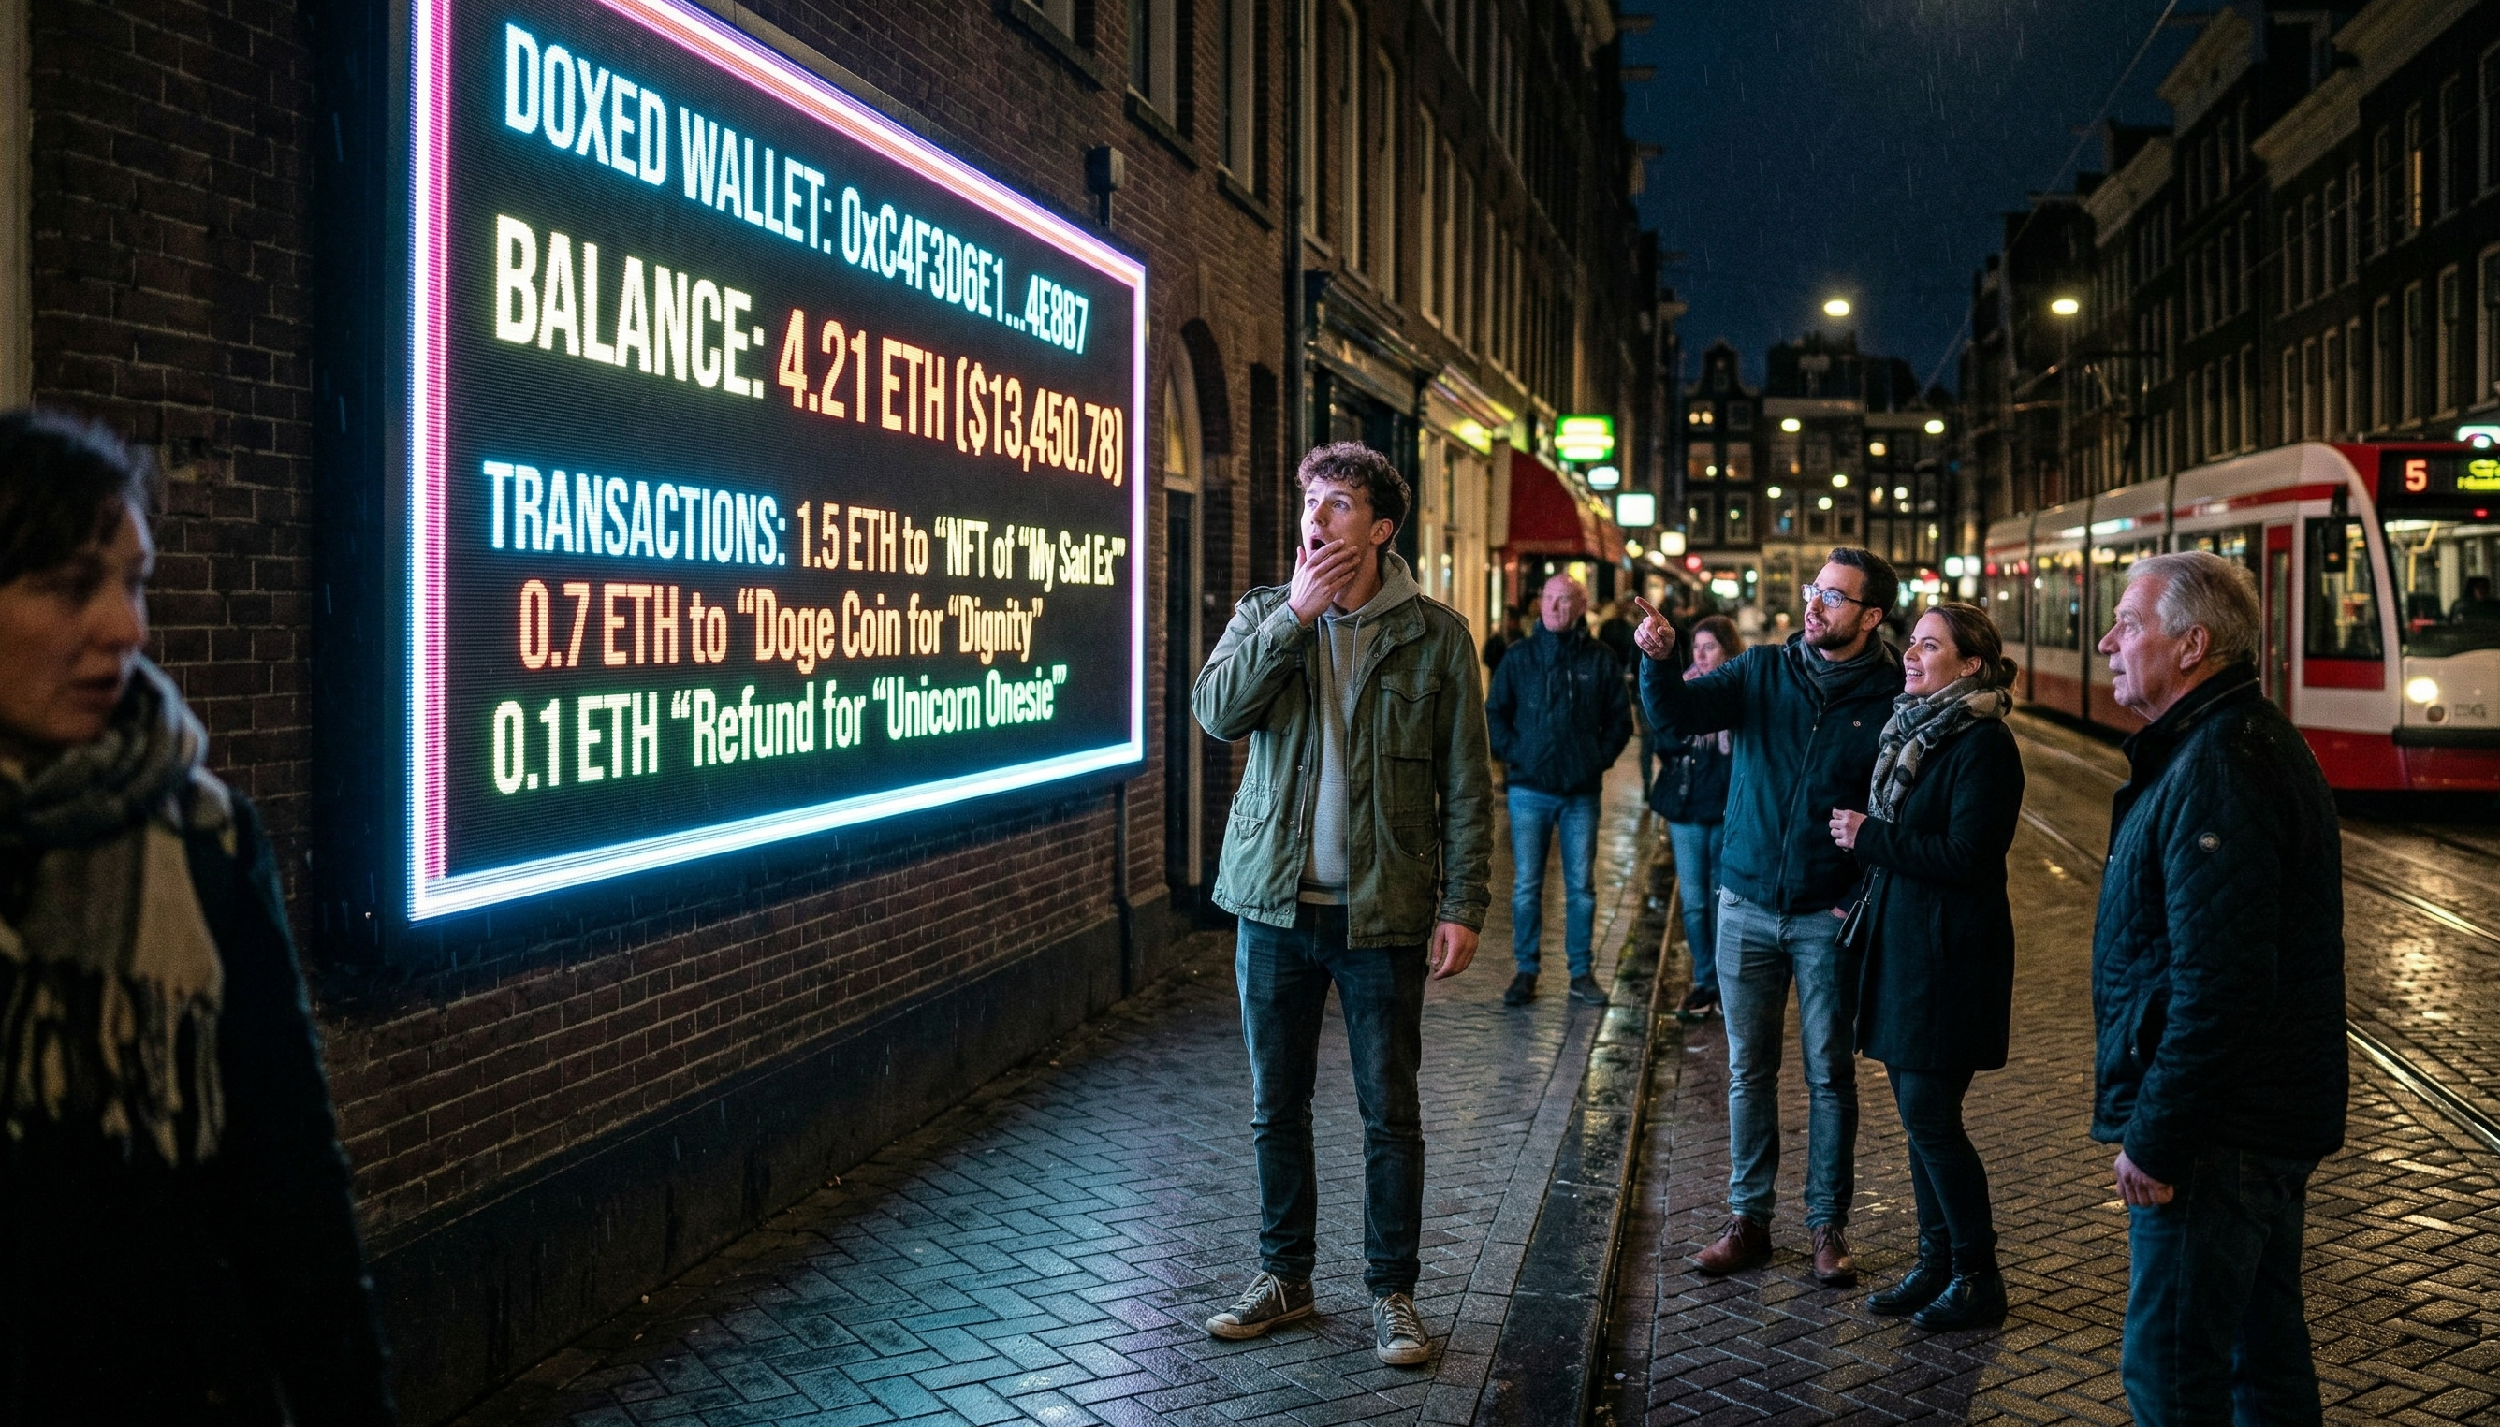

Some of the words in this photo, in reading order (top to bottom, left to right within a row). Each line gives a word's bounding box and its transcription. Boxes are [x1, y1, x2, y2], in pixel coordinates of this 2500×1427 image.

[505, 23, 666, 187] DOXED
[679, 108, 832, 255] WALLET:
[496, 214, 765, 398] BALANCE:
[778, 309, 867, 424] 4.21
[881, 337, 945, 442] ETH
[956, 357, 1124, 487] ($13,450.78)
[484, 461, 786, 566] TRANSACTIONS:
[797, 501, 840, 570] 1.5
[848, 507, 898, 573] ETH
[902, 516, 929, 575] to
[992, 524, 1015, 579] of
[1059, 530, 1091, 584] Sad
[2405, 459, 2427, 492] 5
[518, 580, 590, 669] 0.7
[604, 584, 679, 665] ETH
[689, 592, 727, 663] to
[842, 590, 900, 658] Coin
[907, 593, 944, 655] for
[493, 699, 560, 795] 0.1
[577, 691, 658, 783] ETH
[823, 679, 867, 750] for
